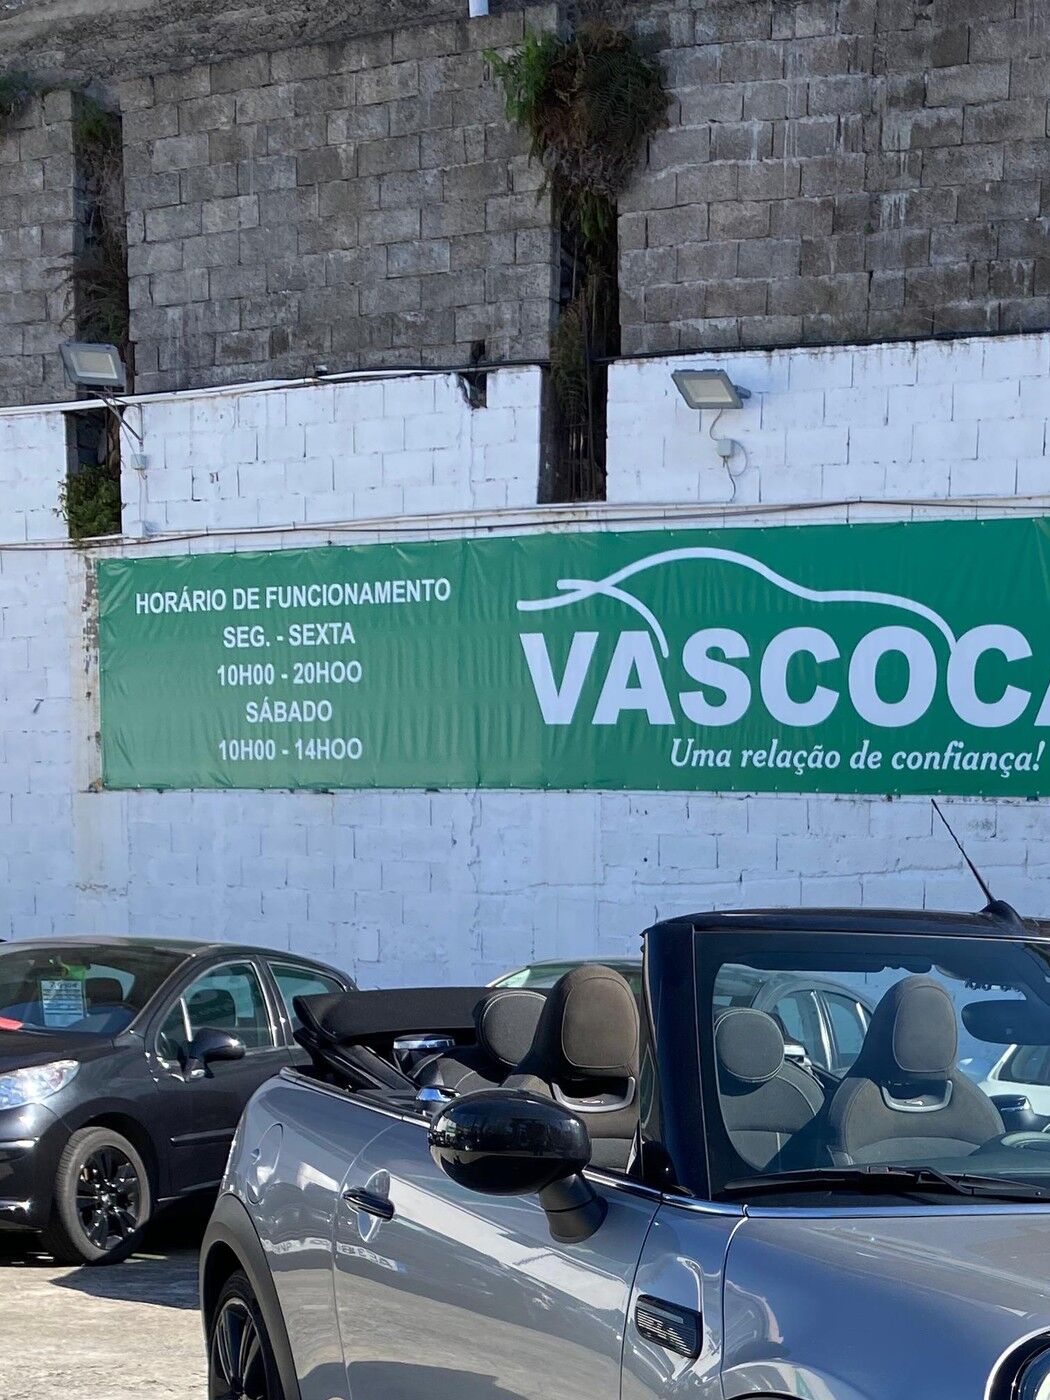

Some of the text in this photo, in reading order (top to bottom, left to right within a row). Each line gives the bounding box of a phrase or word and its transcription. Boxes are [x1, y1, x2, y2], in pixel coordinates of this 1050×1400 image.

[136, 578, 451, 614] HORÁRIO DE FUNCIONAMENTO
[223, 625, 271, 648] SEG.
[288, 622, 356, 647] SEXTA
[217, 663, 275, 686] 10H00
[245, 697, 333, 723] SÁBADO
[218, 739, 276, 761] 10H00
[670, 739, 1046, 778] Uma relação de confiança!
